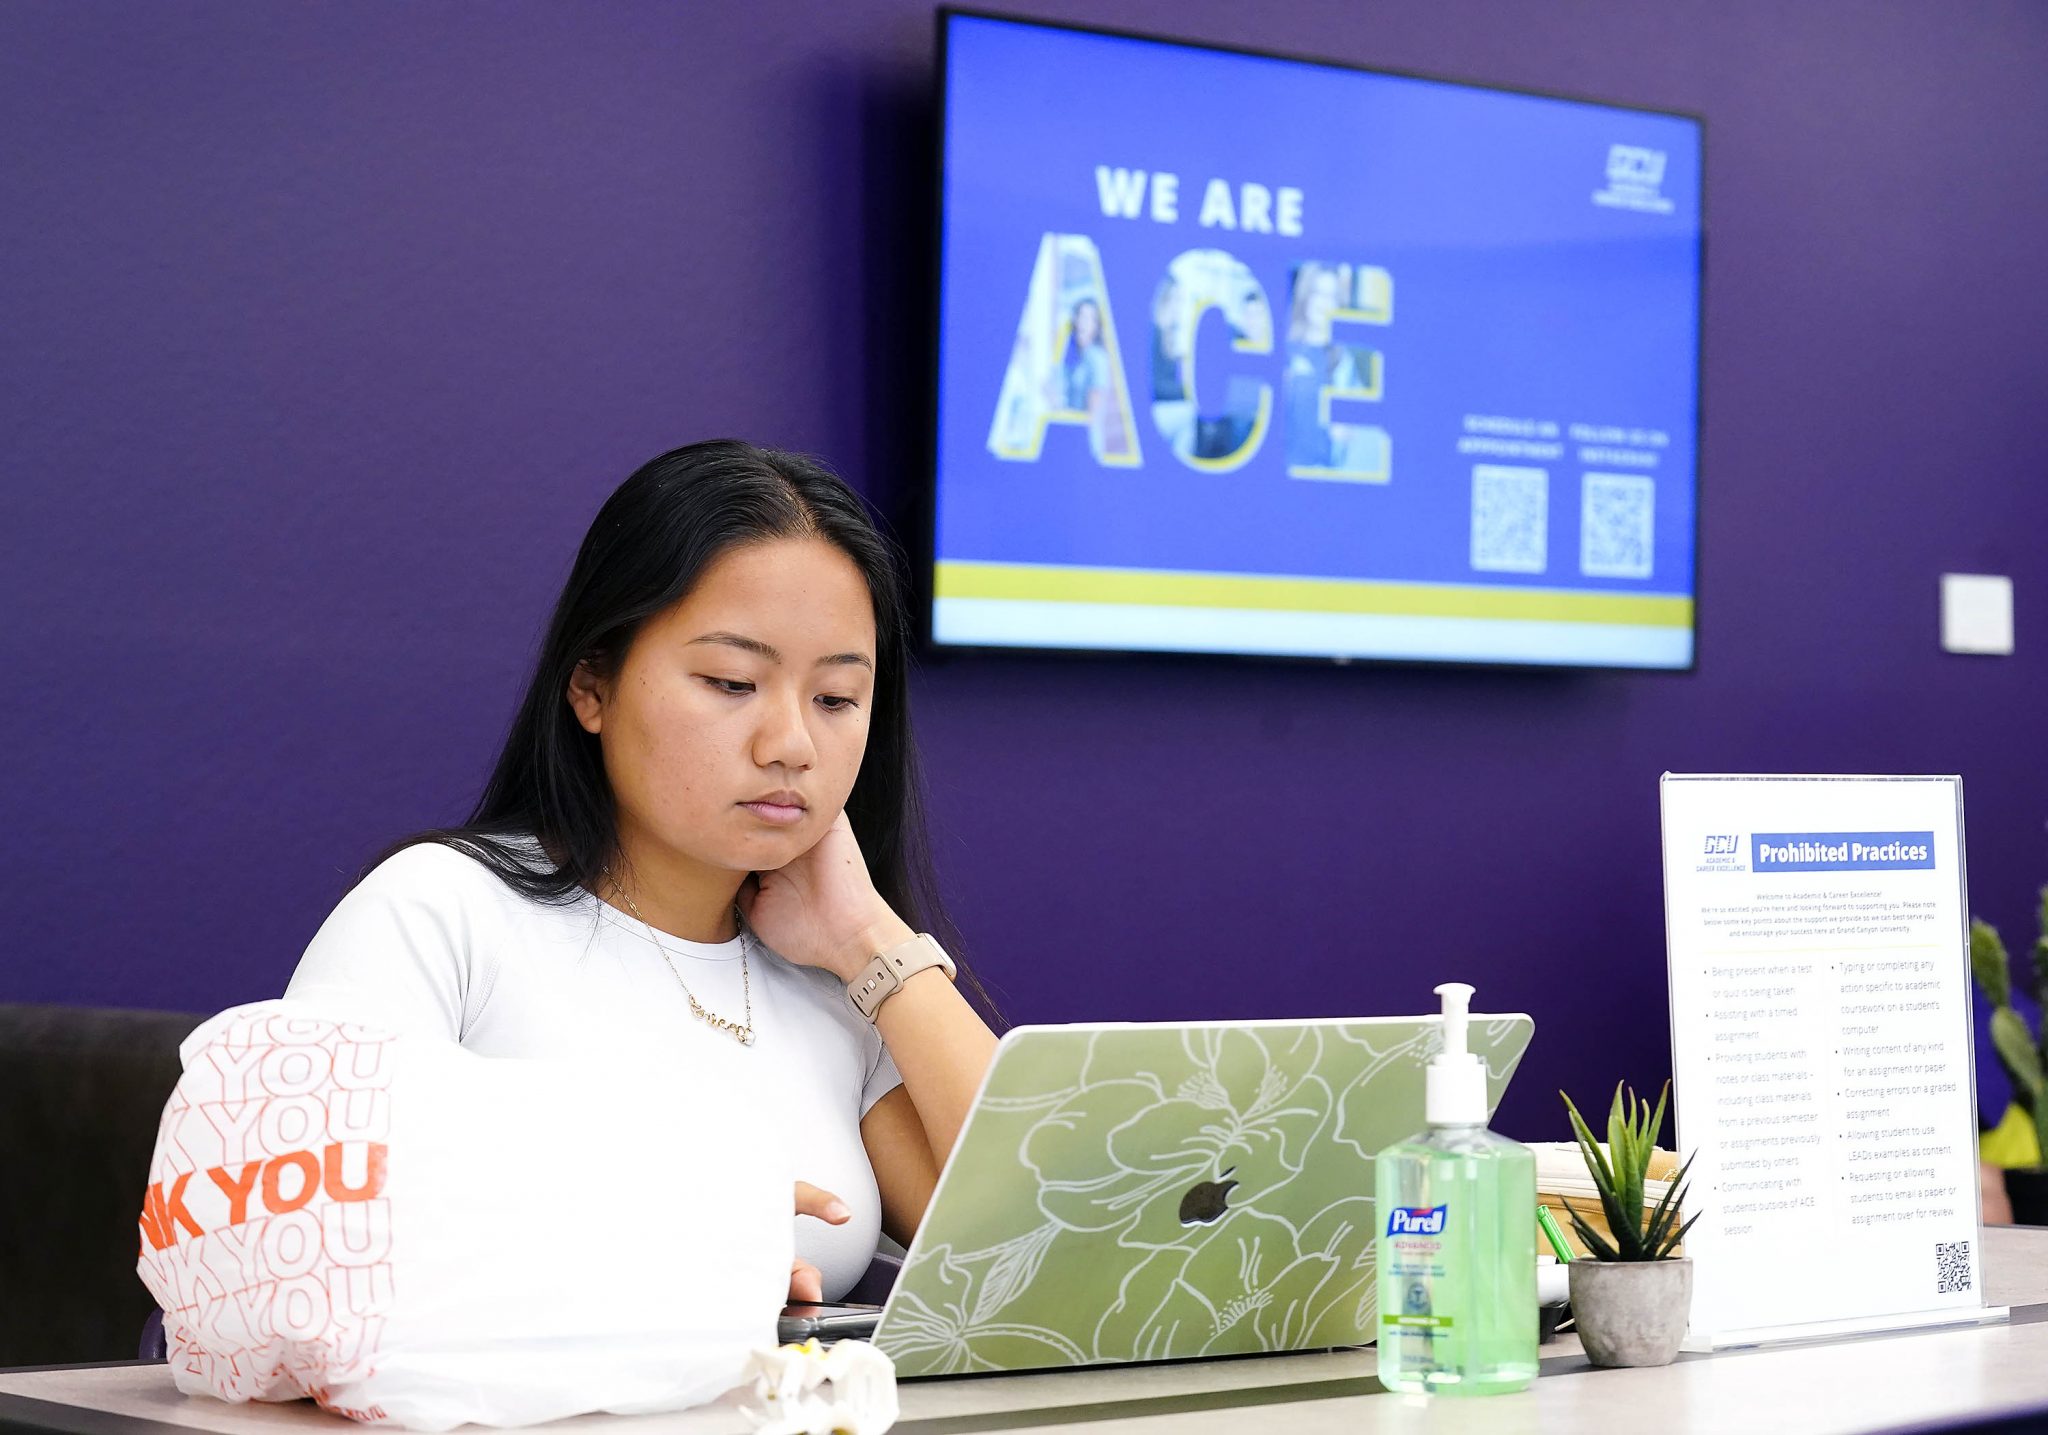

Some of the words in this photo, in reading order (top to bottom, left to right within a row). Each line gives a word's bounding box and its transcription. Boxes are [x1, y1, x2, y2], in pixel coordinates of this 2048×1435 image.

[1095, 165, 1178, 223] WE
[1200, 178, 1304, 238] ARE
[987, 231, 1394, 485] ACE
[1704, 835, 1739, 854] GCU
[1759, 842, 1848, 863] Prohibited
[1852, 840, 1928, 861] Practices
[1751, 906, 1769, 914] you're
[1800, 904, 1821, 913] looking
[1822, 903, 1846, 911] forward
[1856, 903, 1887, 911] supporting
[1741, 918, 1751, 926] key
[1753, 917, 1772, 925] points
[1804, 916, 1827, 924] support
[1840, 915, 1861, 923] provide
[1742, 930, 1773, 938] encourage
[1775, 929, 1789, 937] your
[1857, 926, 1878, 935] Canyon
[1712, 967, 1734, 979] Being
[1736, 967, 1765, 977] present
[1768, 966, 1789, 974] when
[1798, 965, 1812, 973] test
[1839, 962, 1865, 974] Typing
[1877, 961, 1919, 972] completing
[1921, 961, 1934, 971] any
[1712, 990, 1720, 998] or
[1742, 989, 1748, 997] is
[1750, 988, 1771, 998] being
[1773, 987, 1794, 996] taken
[1840, 983, 1863, 993] action
[1865, 981, 1893, 993] specific
[1895, 982, 1903, 990] to
[1905, 980, 1941, 990] academic
[1714, 1011, 1747, 1021] Assisting
[1750, 1009, 1766, 1018] with
[1775, 1008, 1797, 1017] timed
[1841, 1003, 1885, 1014] coursework
[1887, 1004, 1897, 1012] on
[1906, 1001, 1940, 1011] student's
[1714, 1031, 1759, 1043] assignment
[1842, 1025, 1878, 1036] computer
[1843, 1046, 1870, 1057] Writing
[1872, 1044, 1901, 1054] content
[1903, 1043, 1911, 1052] of
[1913, 1044, 1926, 1054] any
[1928, 1042, 1944, 1051] kind
[1715, 1052, 1752, 1064] Providing
[1754, 1051, 1787, 1061] students
[1790, 1050, 1806, 1059] with
[205, 1041, 393, 1105] YOU
[1844, 1067, 1854, 1076] for
[1869, 1065, 1912, 1077] assignment
[1924, 1063, 1946, 1074] paper
[1716, 1075, 1739, 1084] notes
[1751, 1073, 1770, 1082] class
[1772, 1071, 1808, 1081] materials
[1845, 1087, 1884, 1098] Correcting
[1887, 1086, 1910, 1095] errors
[1912, 1086, 1921, 1094] on
[1930, 1082, 1956, 1095] graded
[1717, 1095, 1753, 1107] including
[1755, 1094, 1774, 1103] class
[1775, 1092, 1812, 1102] materials
[1718, 1117, 1737, 1127] from
[1747, 1116, 1780, 1127] previous
[1782, 1113, 1818, 1123] semester
[1846, 1108, 1890, 1121] assignment
[199, 1088, 391, 1167] YOU
[1847, 1129, 1880, 1140] Allowing
[1881, 1126, 1910, 1137] student
[1912, 1127, 1920, 1135] to
[1922, 1126, 1935, 1135] use
[1720, 1141, 1728, 1149] or
[1730, 1137, 1778, 1150] assignments
[1780, 1135, 1821, 1145] previously
[1848, 1150, 1872, 1161] LEADs
[1874, 1148, 1910, 1159] examples
[1912, 1147, 1921, 1156] as
[1922, 1145, 1951, 1155] content
[1721, 1159, 1760, 1170] submitted
[1762, 1159, 1771, 1170] by
[1774, 1157, 1799, 1167] others
[1849, 1171, 1891, 1182] Requesting
[1893, 1170, 1902, 1179] or
[1904, 1168, 1935, 1178] allowing
[206, 1141, 389, 1227] YOU
[1721, 1179, 1783, 1192] Communicating
[1785, 1178, 1801, 1187] with
[1850, 1192, 1883, 1204] students
[1885, 1191, 1893, 1201] to
[1895, 1189, 1916, 1199] email
[1924, 1188, 1947, 1200] paper
[1949, 1186, 1957, 1195] or
[1723, 1202, 1757, 1214] students
[1759, 1199, 1787, 1210] outside
[1790, 1197, 1798, 1208] of
[1800, 1196, 1815, 1207] ACE
[1392, 1209, 1443, 1232] Purell
[1852, 1212, 1895, 1225] assignment
[1897, 1210, 1913, 1220] over
[1916, 1208, 1927, 1219] for
[1929, 1207, 1954, 1217] review
[1724, 1225, 1752, 1235] session
[213, 1197, 393, 1293] YOU
